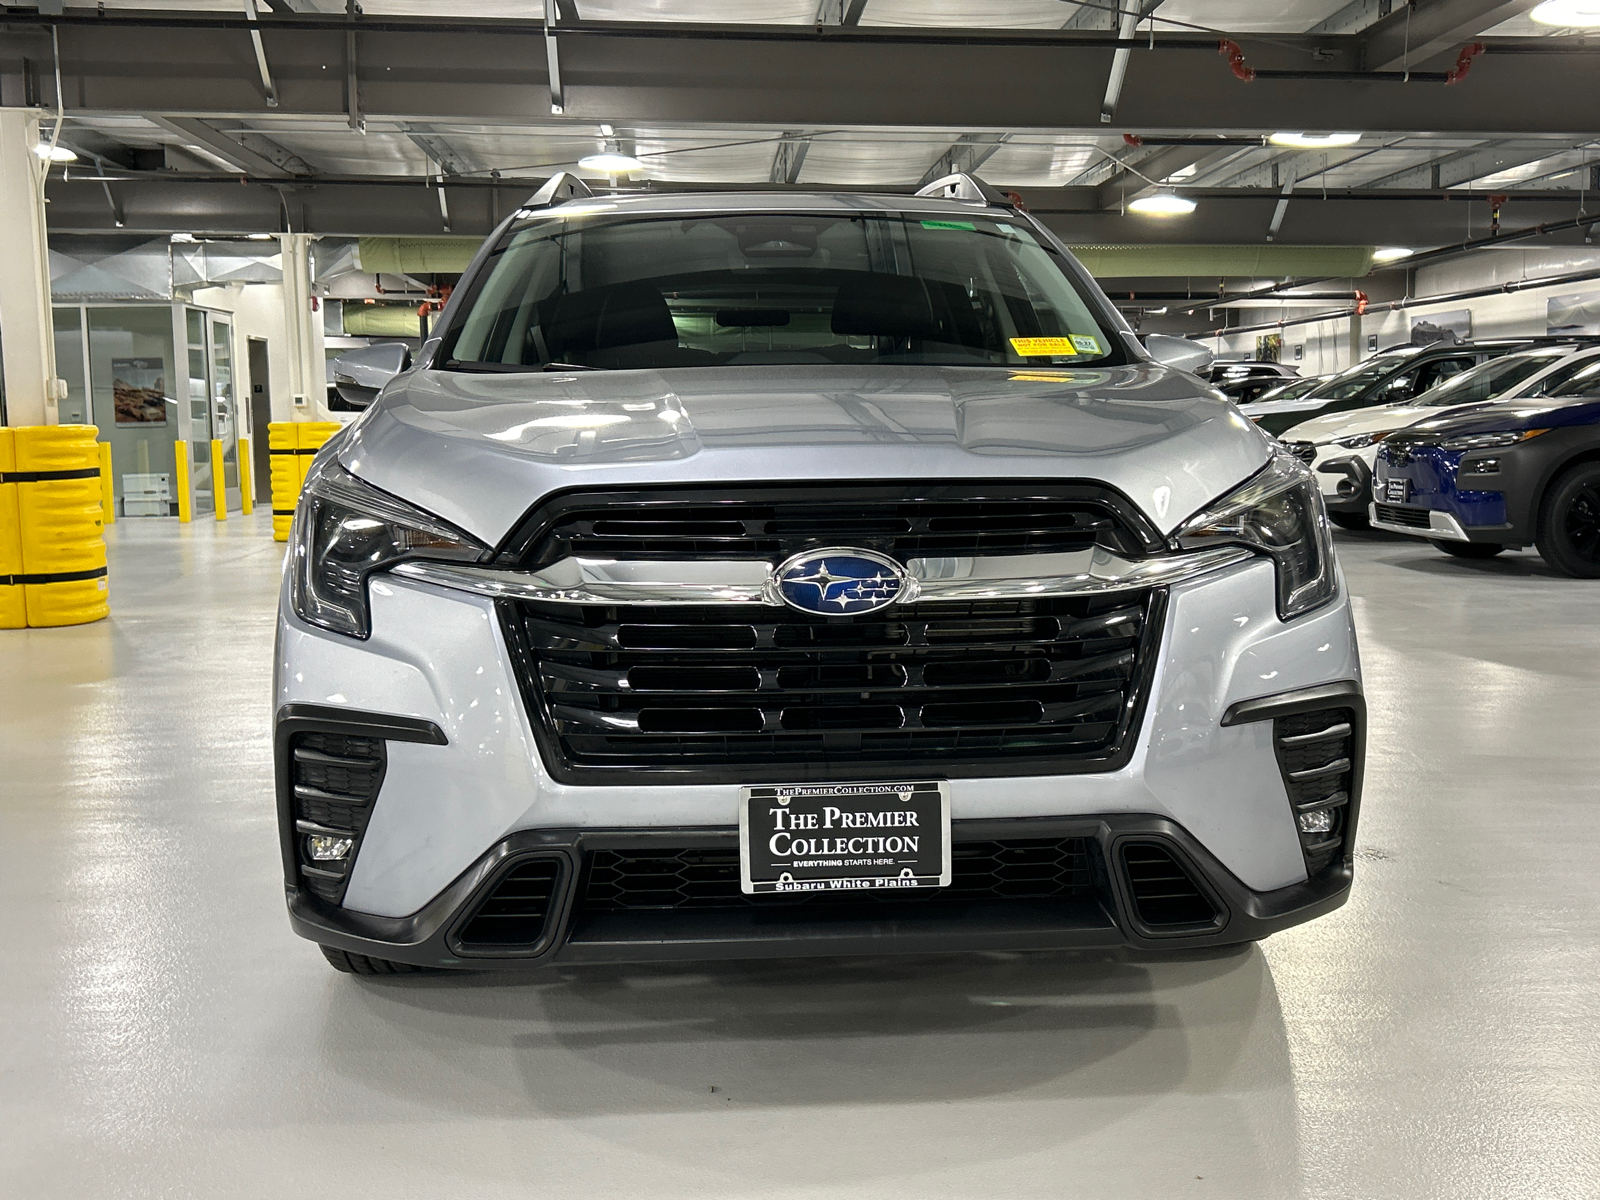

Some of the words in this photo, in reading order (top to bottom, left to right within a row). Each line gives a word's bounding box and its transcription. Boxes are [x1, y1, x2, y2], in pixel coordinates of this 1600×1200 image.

[769, 808, 819, 830] THE
[823, 807, 919, 829] PREMIER
[769, 832, 919, 856] COLLECTION
[775, 881, 825, 891] Subaru
[829, 879, 870, 888] White
[875, 878, 919, 887] Plains
